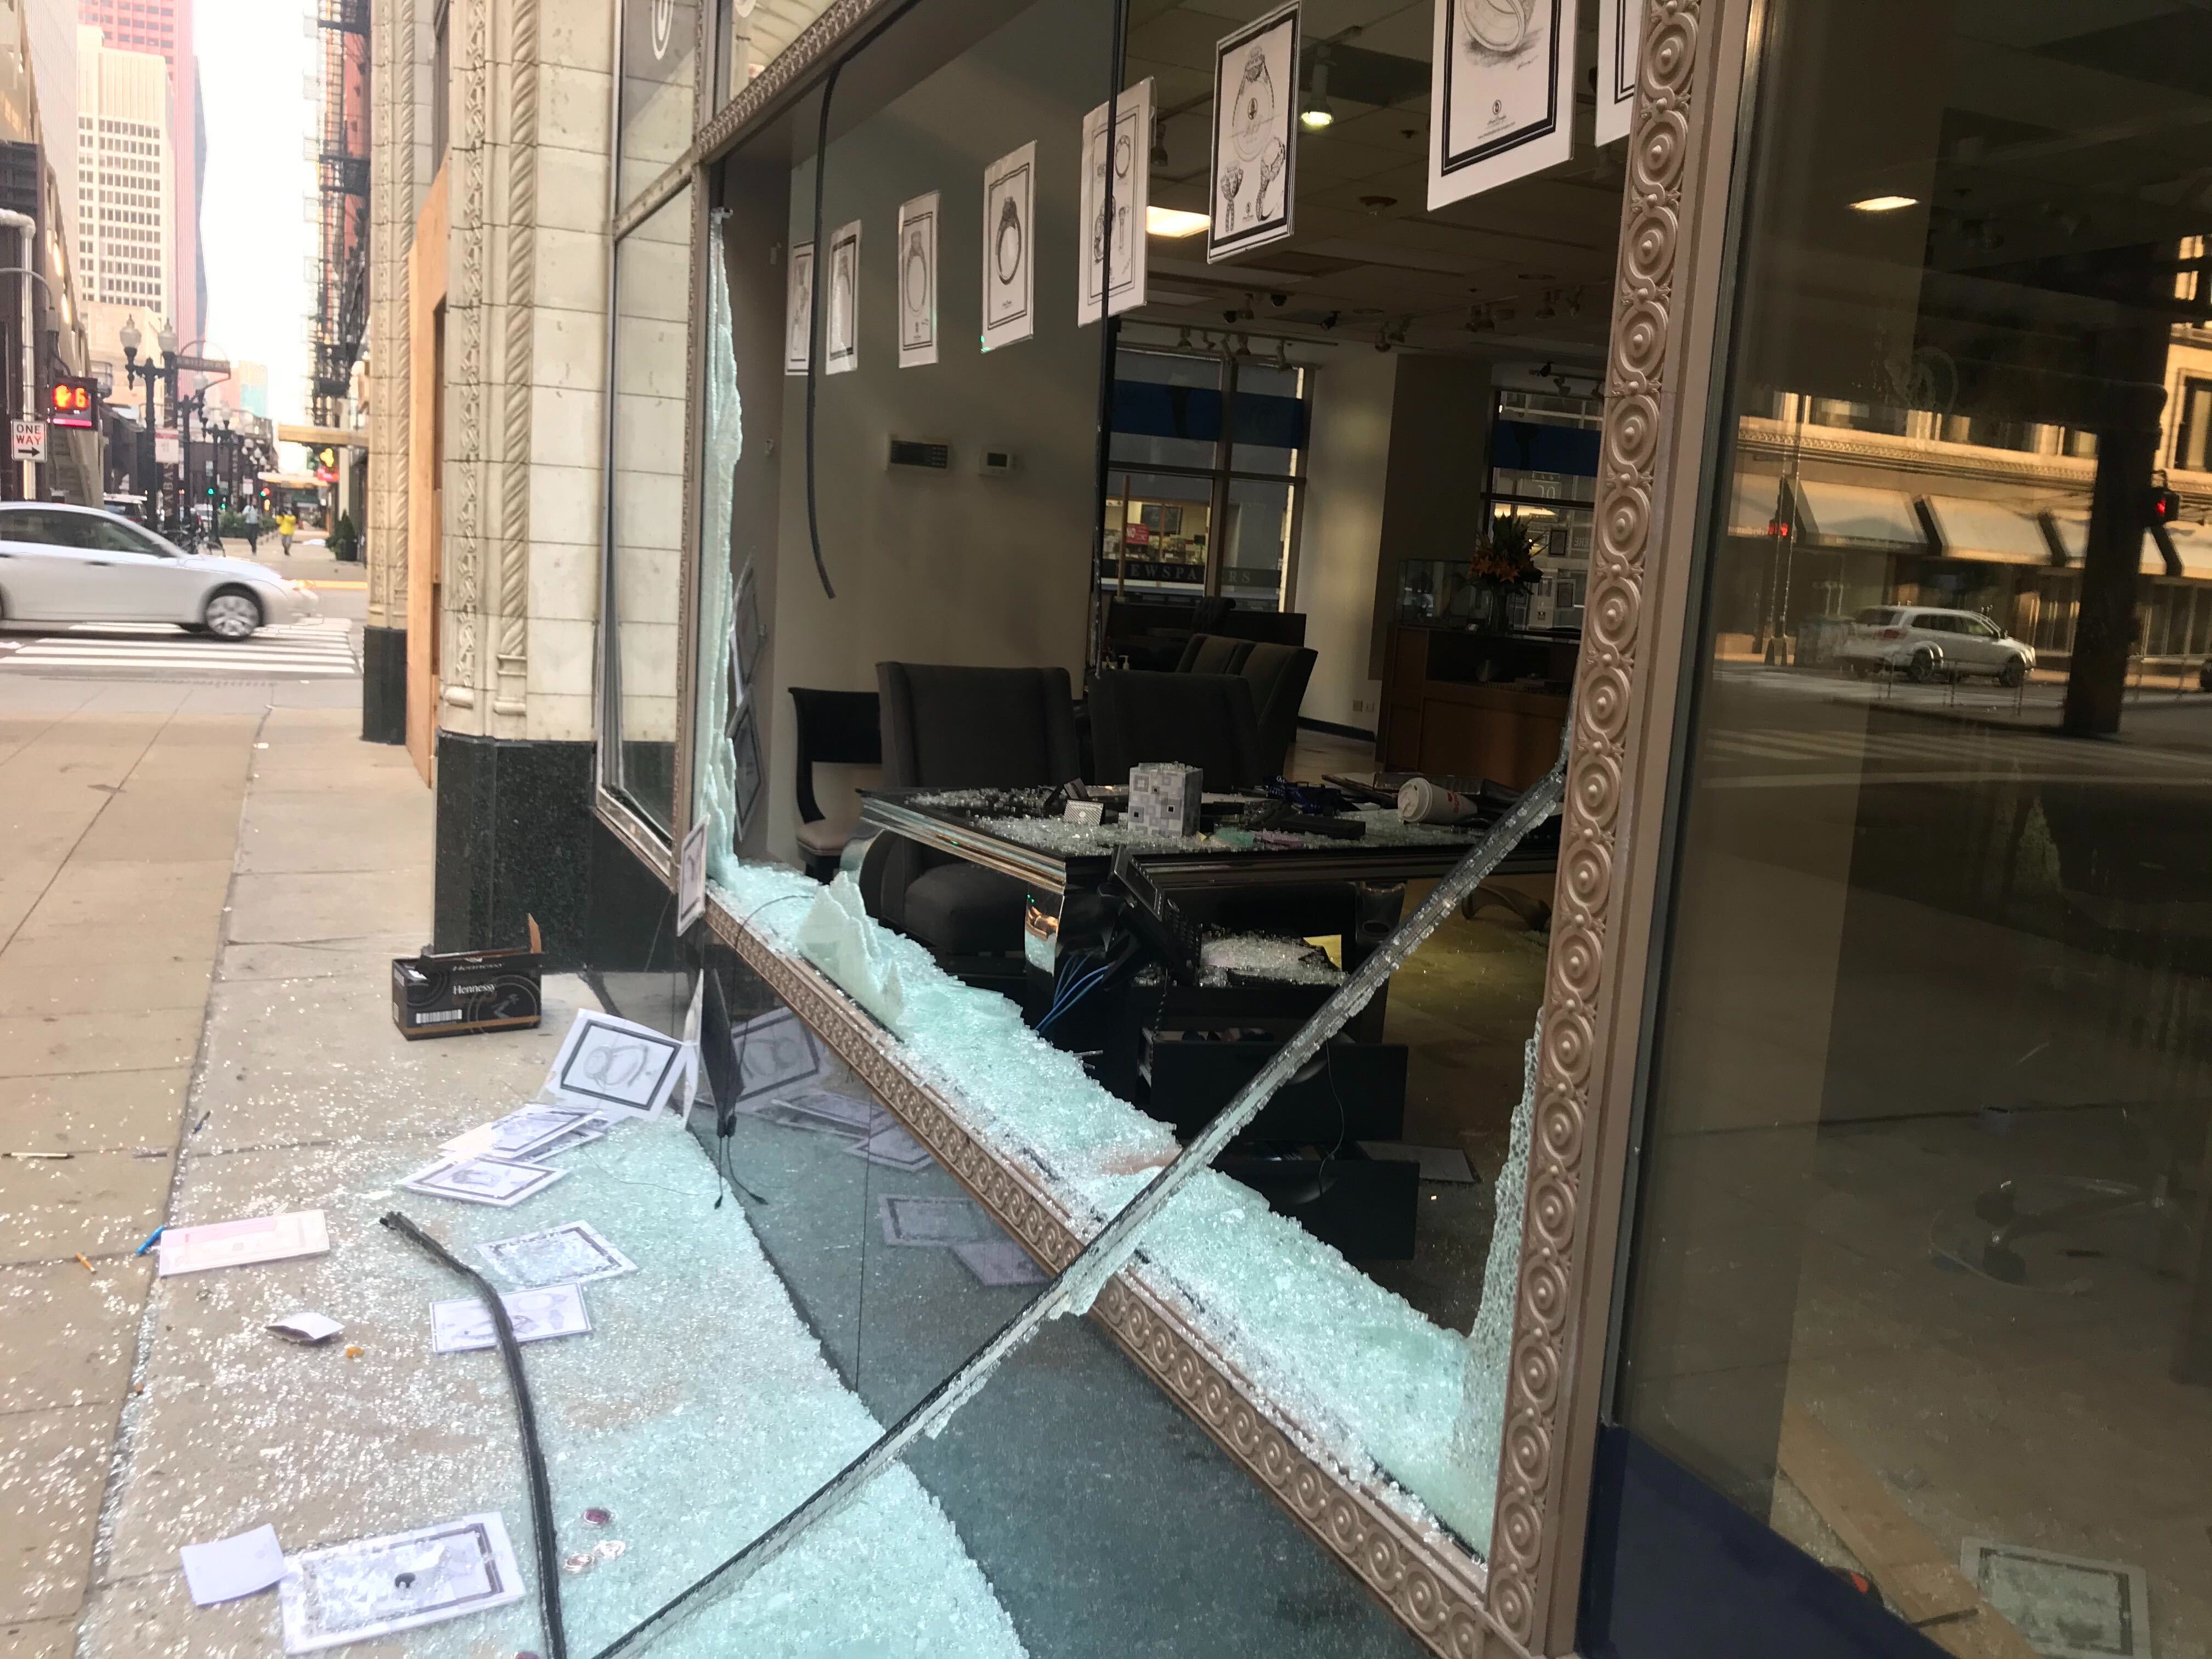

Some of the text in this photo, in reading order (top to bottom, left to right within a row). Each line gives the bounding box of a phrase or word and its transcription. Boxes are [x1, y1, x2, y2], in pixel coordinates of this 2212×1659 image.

[75, 387, 87, 408] 6
[16, 425, 41, 434] ONE
[16, 435, 41, 445] WAY
[453, 984, 495, 995] Hennessy
